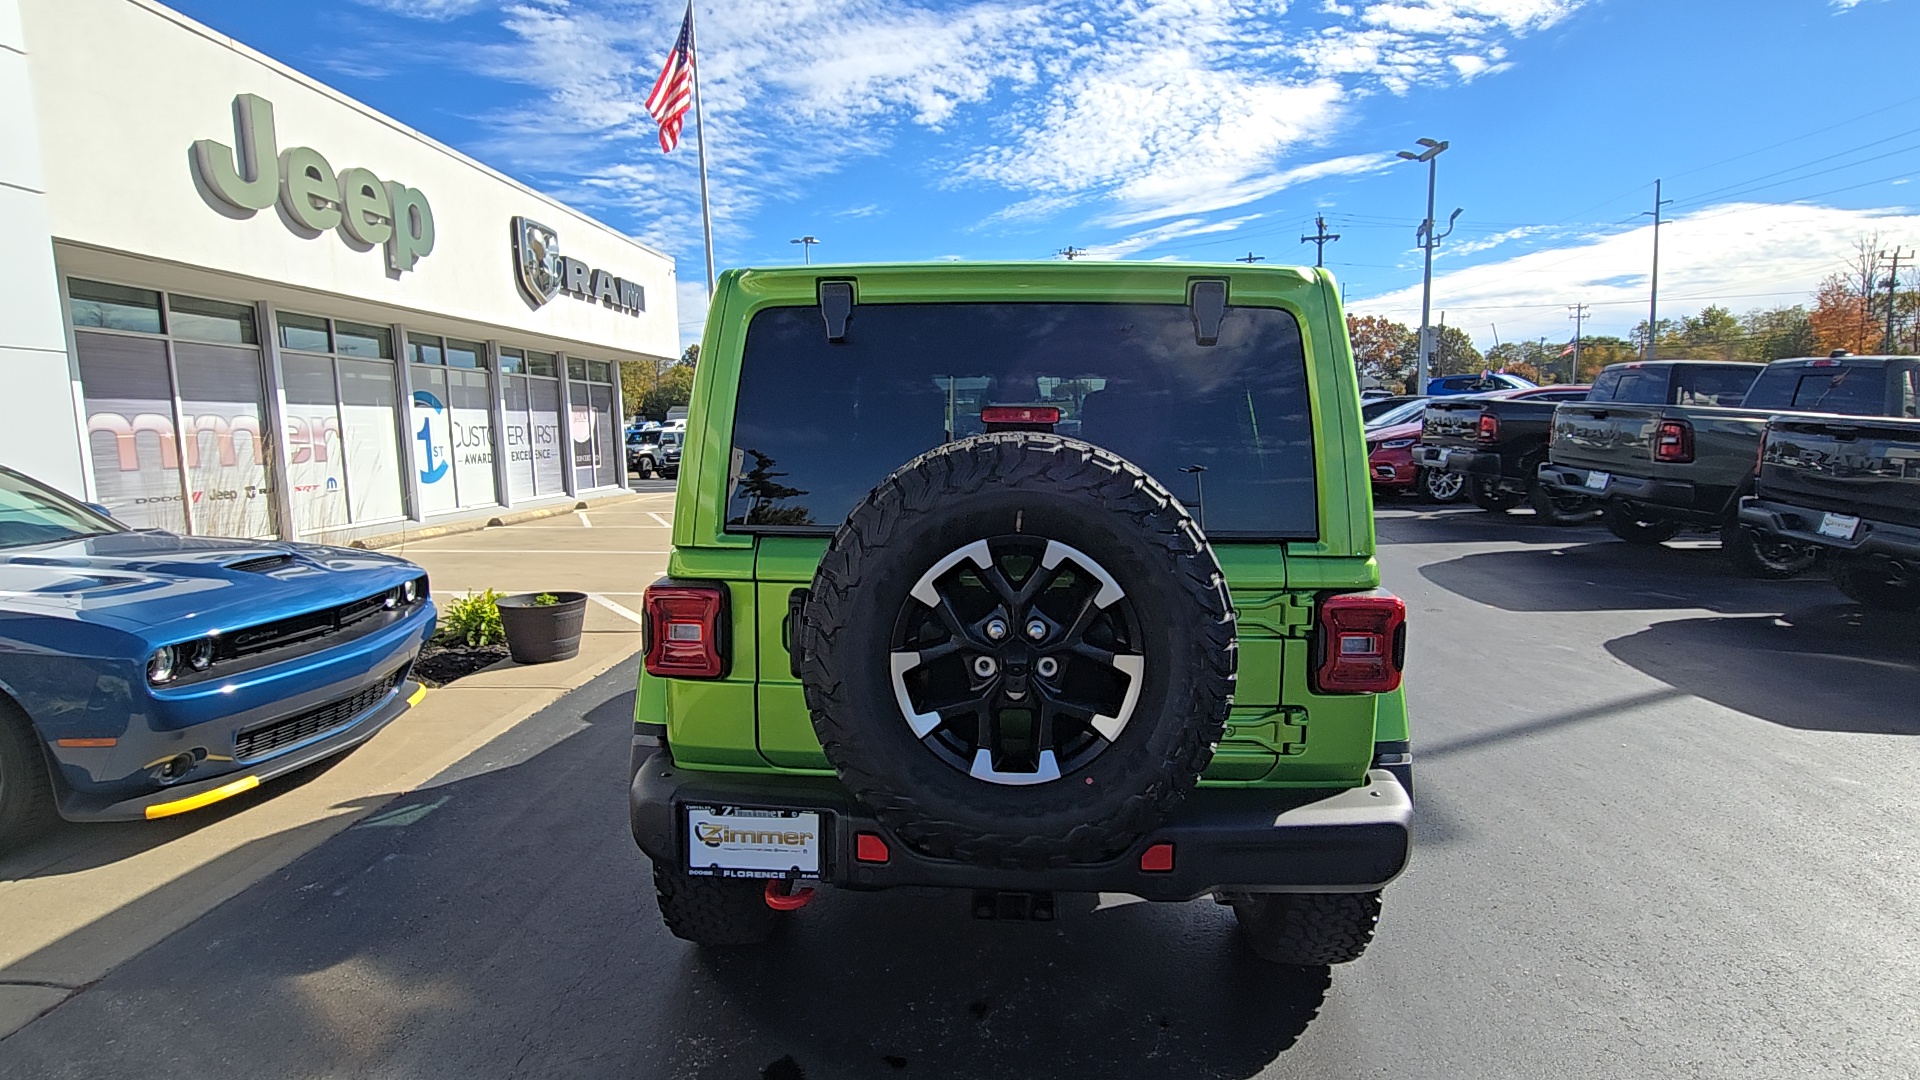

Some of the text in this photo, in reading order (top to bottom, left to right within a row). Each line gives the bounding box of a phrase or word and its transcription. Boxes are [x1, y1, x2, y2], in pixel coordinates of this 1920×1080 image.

[190, 93, 435, 274] Jeep
[559, 256, 646, 313] RAM
[1799, 449, 1883, 470] RAM
[209, 488, 238, 501] Jeep
[294, 484, 319, 493] SRT
[721, 805, 785, 818] Zimmer
[701, 823, 814, 846] Zimmer
[723, 869, 787, 879] FLORENCE
